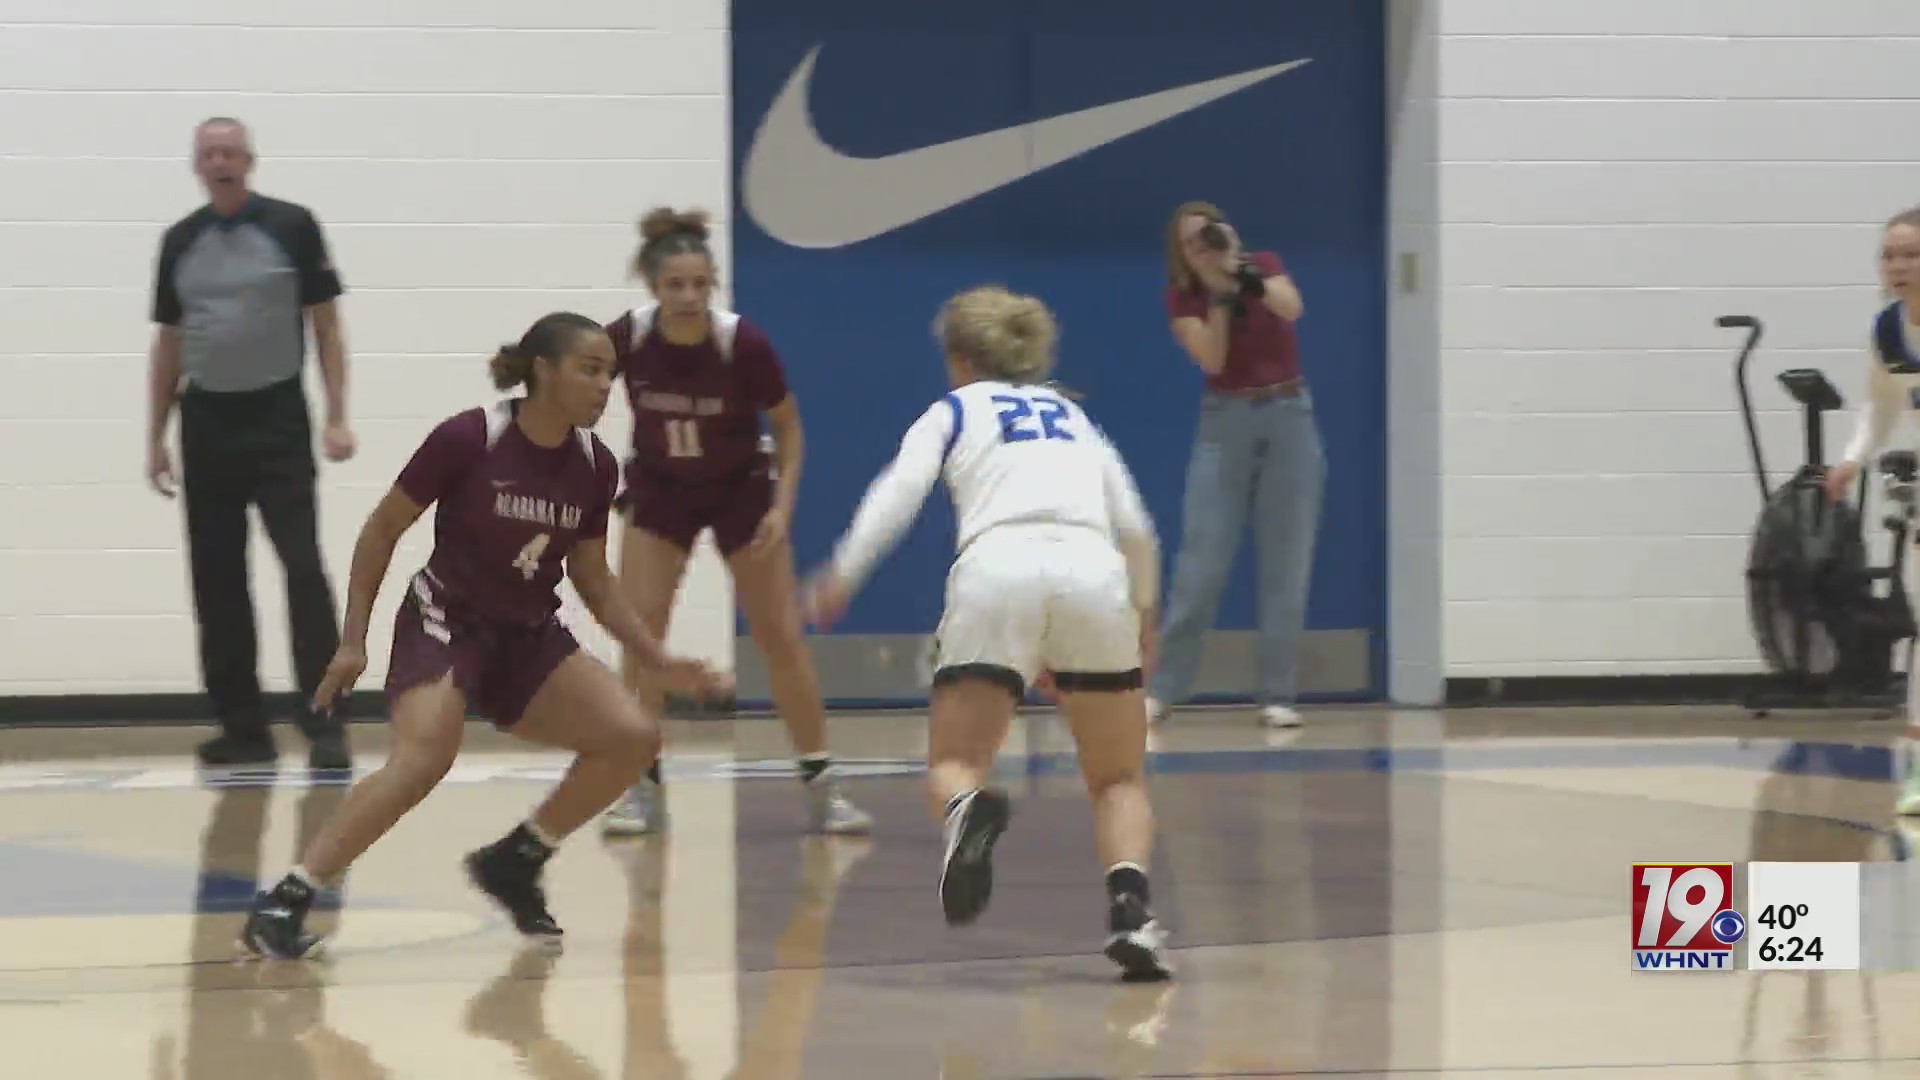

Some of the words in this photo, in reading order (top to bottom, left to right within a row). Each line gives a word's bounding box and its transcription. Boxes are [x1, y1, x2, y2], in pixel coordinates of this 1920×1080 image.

[665, 419, 703, 457] 11
[992, 395, 1074, 443] 22
[512, 533, 551, 580] 4
